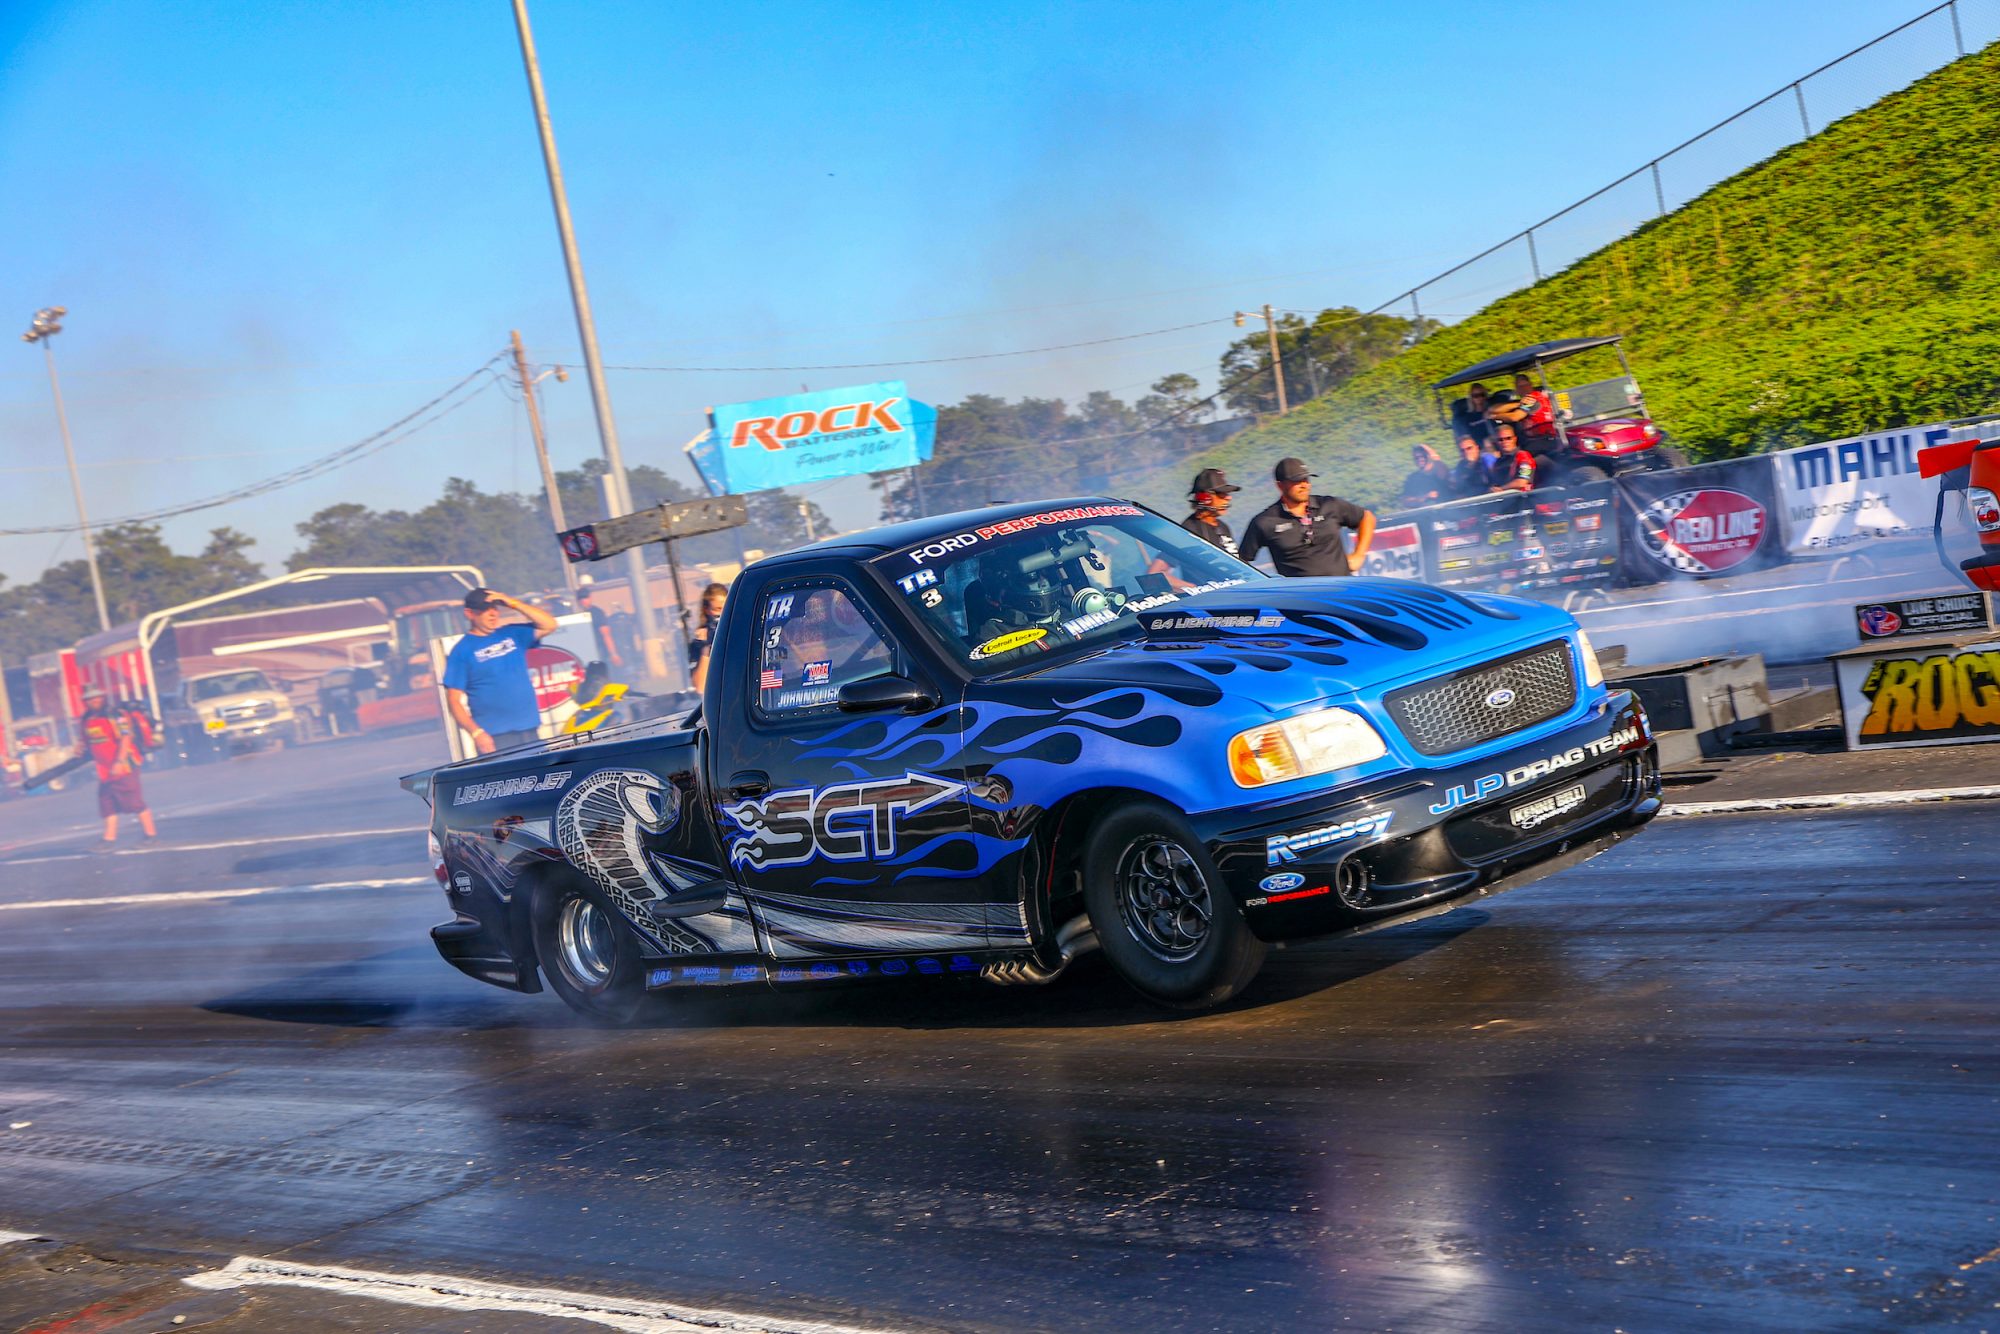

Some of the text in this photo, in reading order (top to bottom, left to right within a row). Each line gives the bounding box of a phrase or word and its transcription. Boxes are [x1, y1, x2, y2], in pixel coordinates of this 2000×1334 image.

[730, 397, 904, 451] ROCK
[1791, 493, 1891, 522] Motorsport
[908, 505, 1145, 565] FORD PERFORMANCE
[1674, 507, 1761, 543] RED LINE
[1808, 530, 1872, 549] Pistons
[896, 568, 939, 595] TR
[766, 593, 795, 621] TR
[921, 588, 943, 608] 3
[1125, 593, 1180, 613] Holley
[1062, 607, 1120, 636] NMRA
[1174, 615, 1255, 629] LIGHTNING
[1253, 616, 1287, 628] JET
[1908, 611, 1980, 626] OFFICIAL
[767, 625, 783, 649] 3
[777, 686, 841, 708] JOHNNY LIGH
[1428, 725, 1640, 815] JLP DRAG TEAM
[453, 770, 573, 806] LIGHTNING JET
[735, 774, 950, 869] SCT
[1265, 810, 1396, 867] Ramsey
[1266, 875, 1298, 890] Ford
[1246, 897, 1268, 907] FORD
